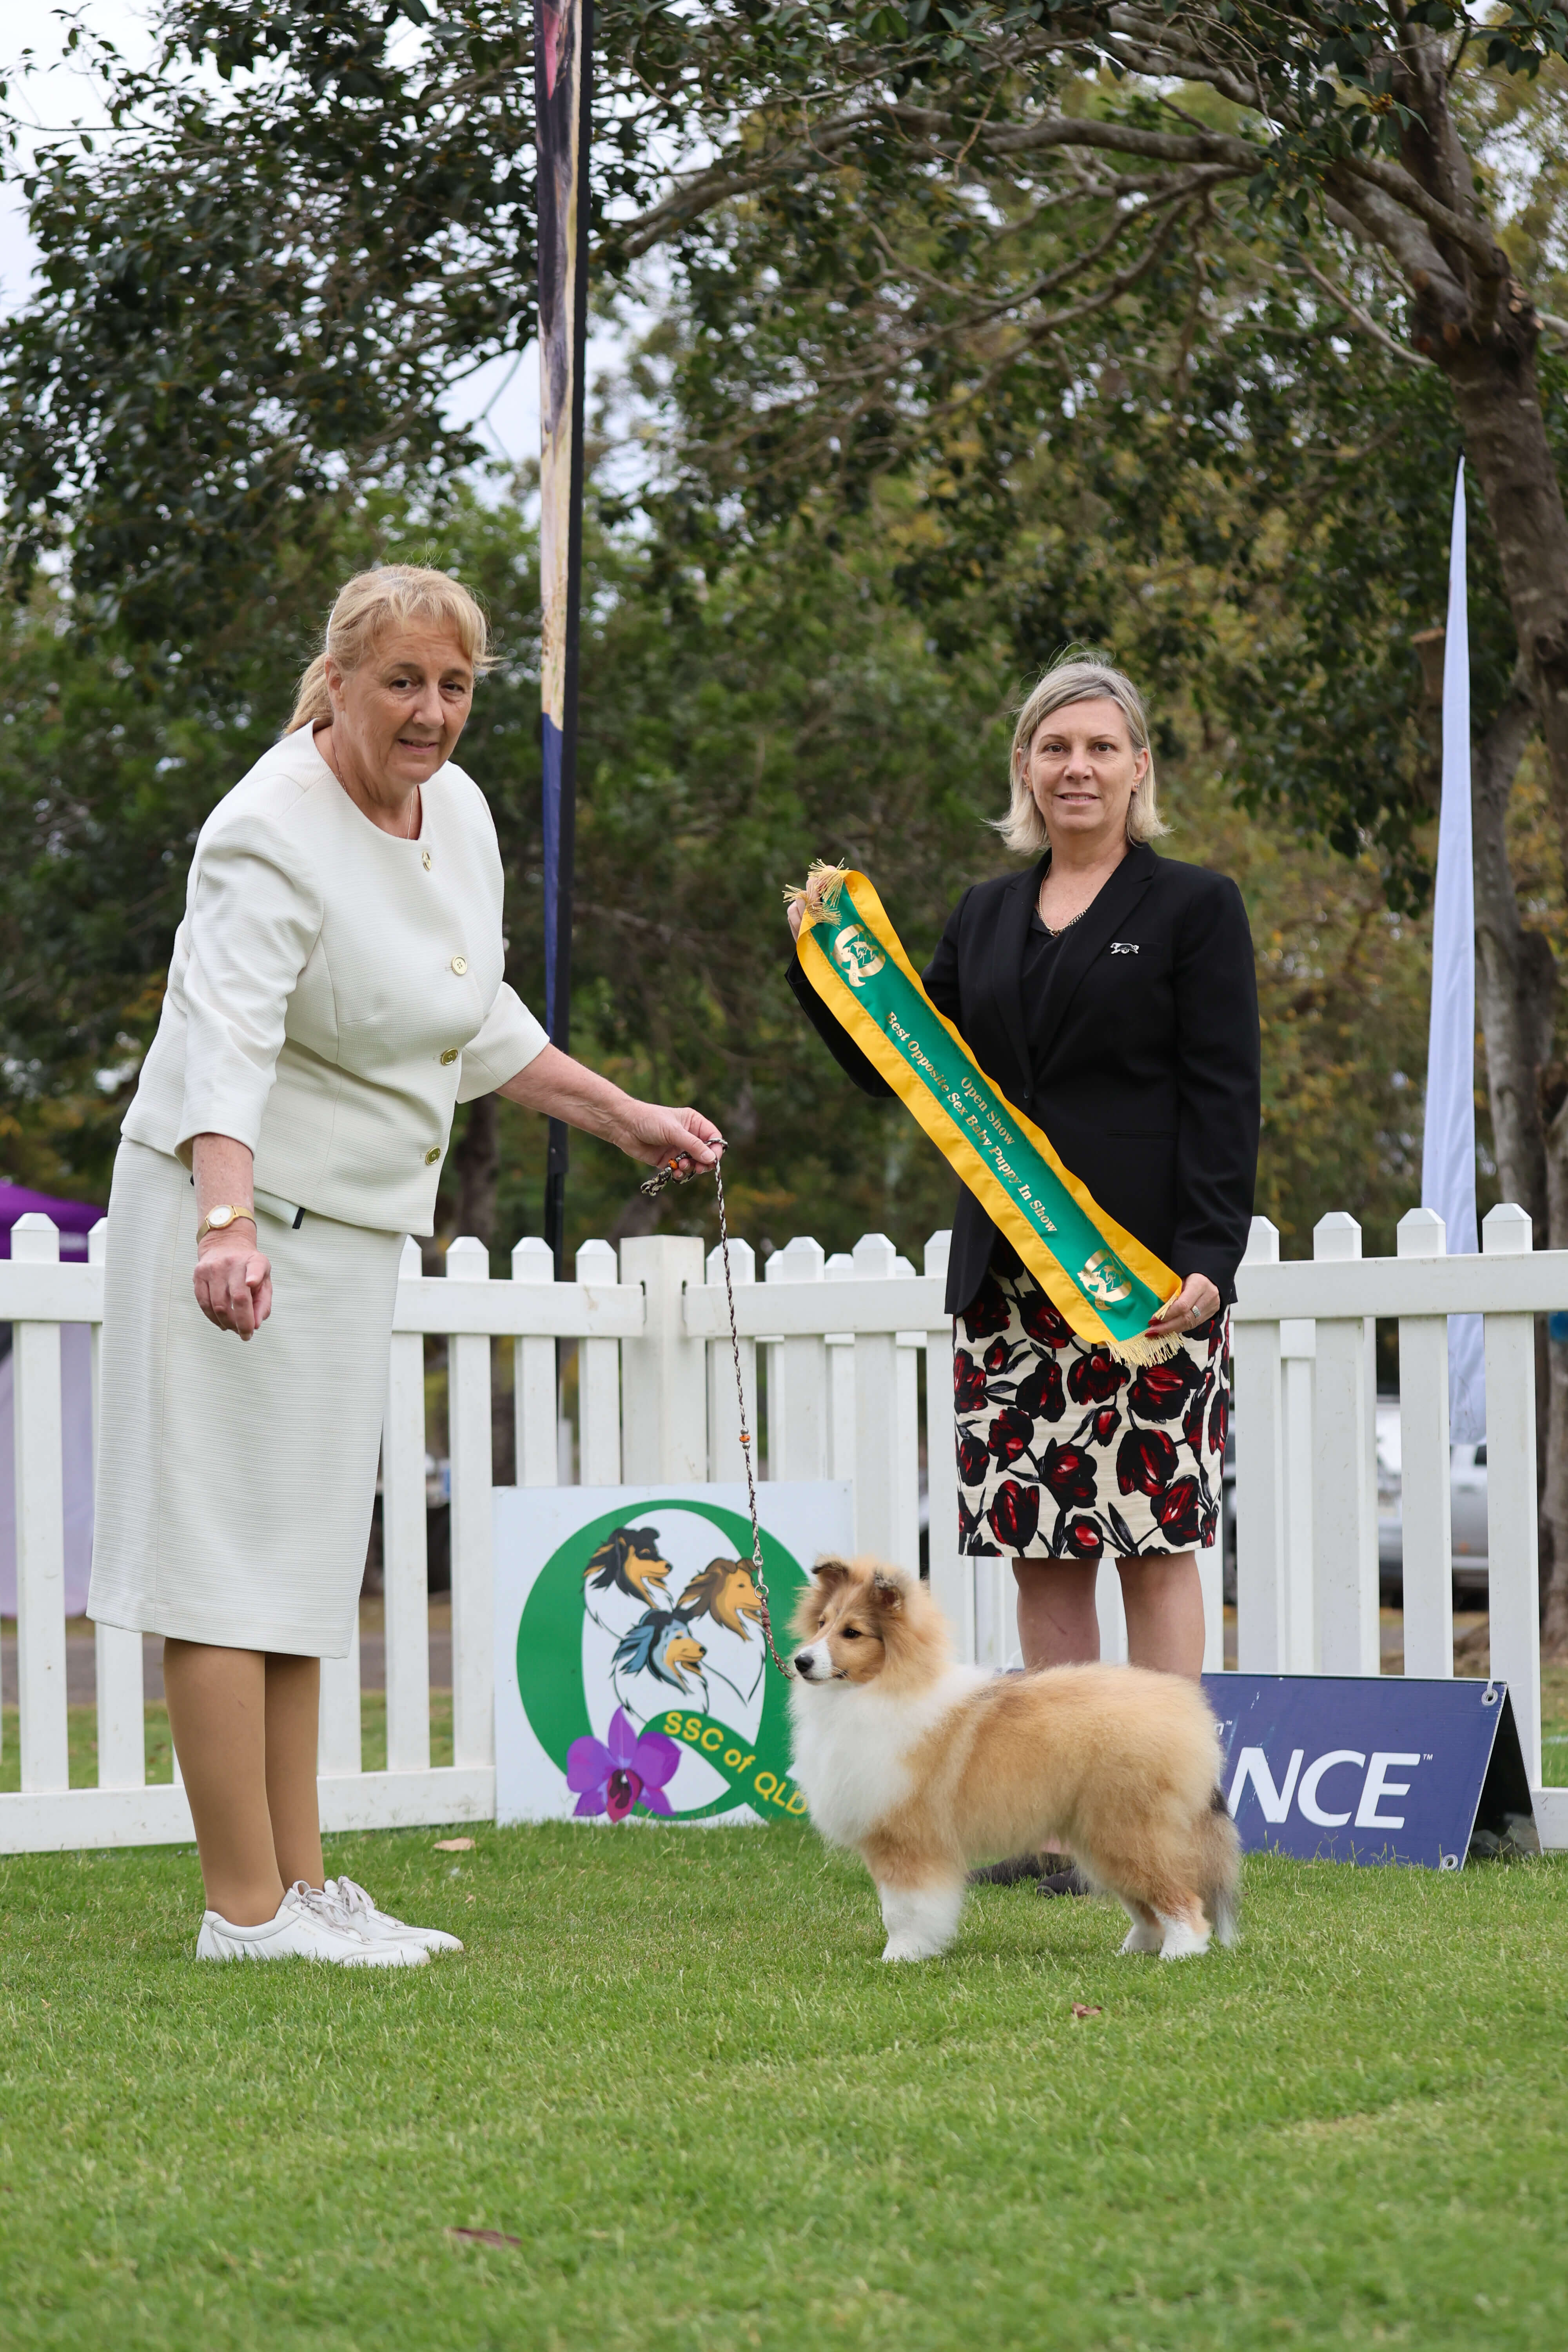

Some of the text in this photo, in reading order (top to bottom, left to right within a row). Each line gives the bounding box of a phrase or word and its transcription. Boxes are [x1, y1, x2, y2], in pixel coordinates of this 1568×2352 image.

[886, 1011, 1057, 1231] Best Opposite Sex Baby Puppy In Show
[961, 1077, 1015, 1145] Open Show
[664, 1711, 808, 1815] SSC of QLD
[1227, 1747, 1421, 1829] NCE
